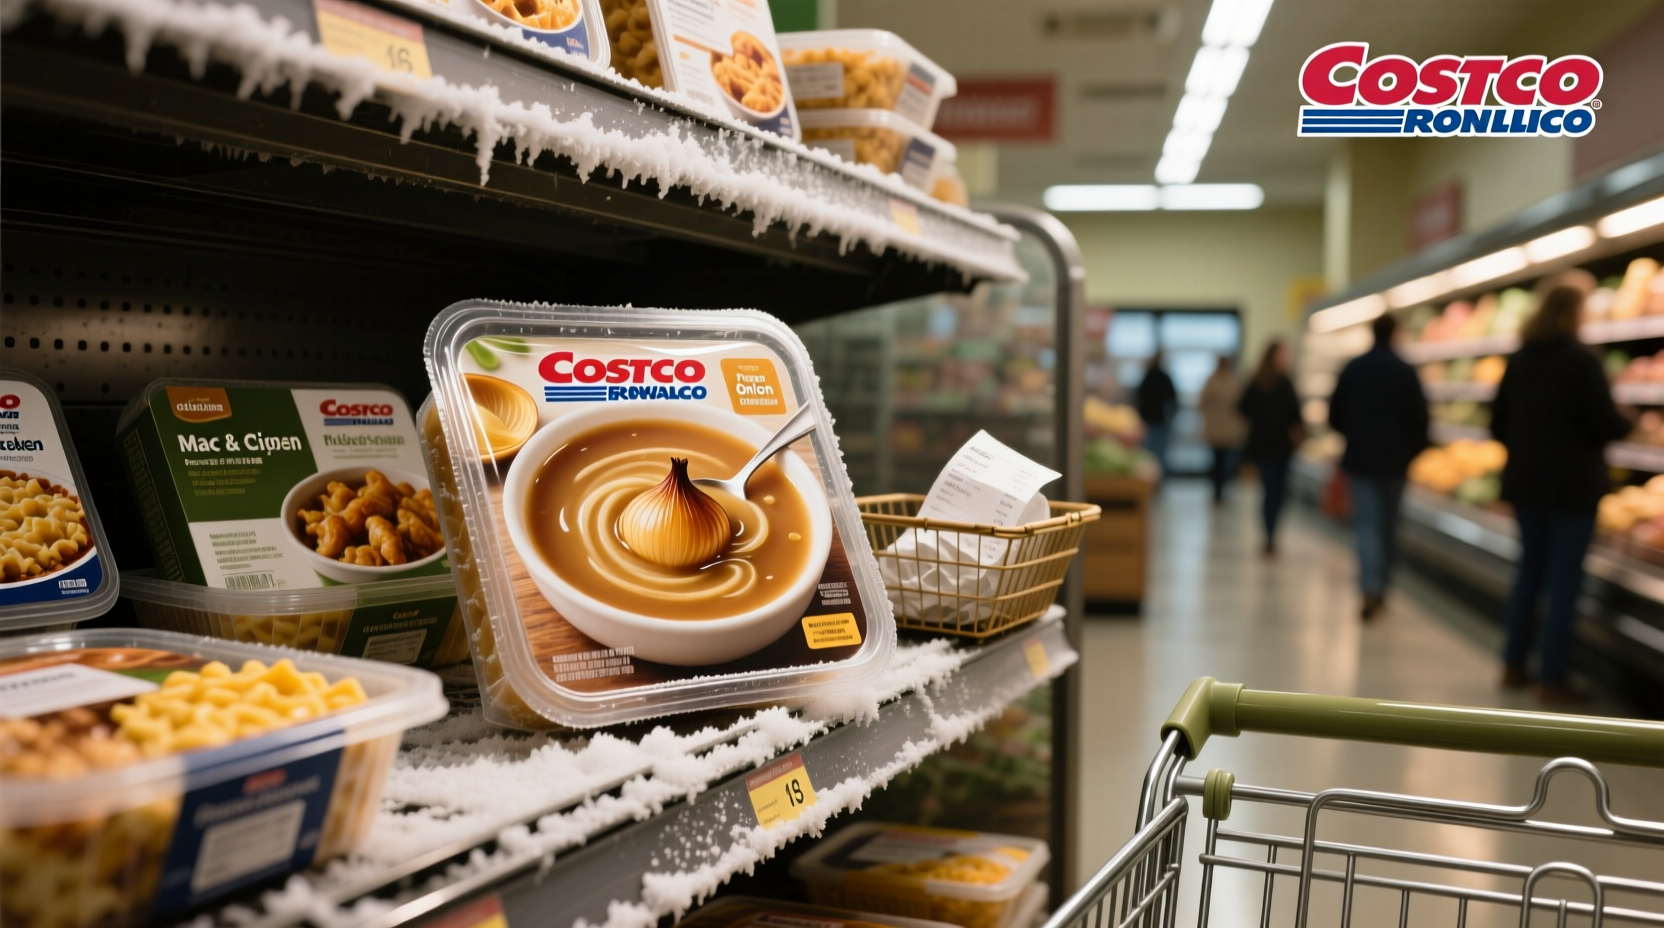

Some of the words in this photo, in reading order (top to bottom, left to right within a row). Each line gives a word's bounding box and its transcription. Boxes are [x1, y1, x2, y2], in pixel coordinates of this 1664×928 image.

[538, 351, 706, 384] COSTCO
[177, 434, 221, 453] Mac
[225, 433, 241, 452] &
